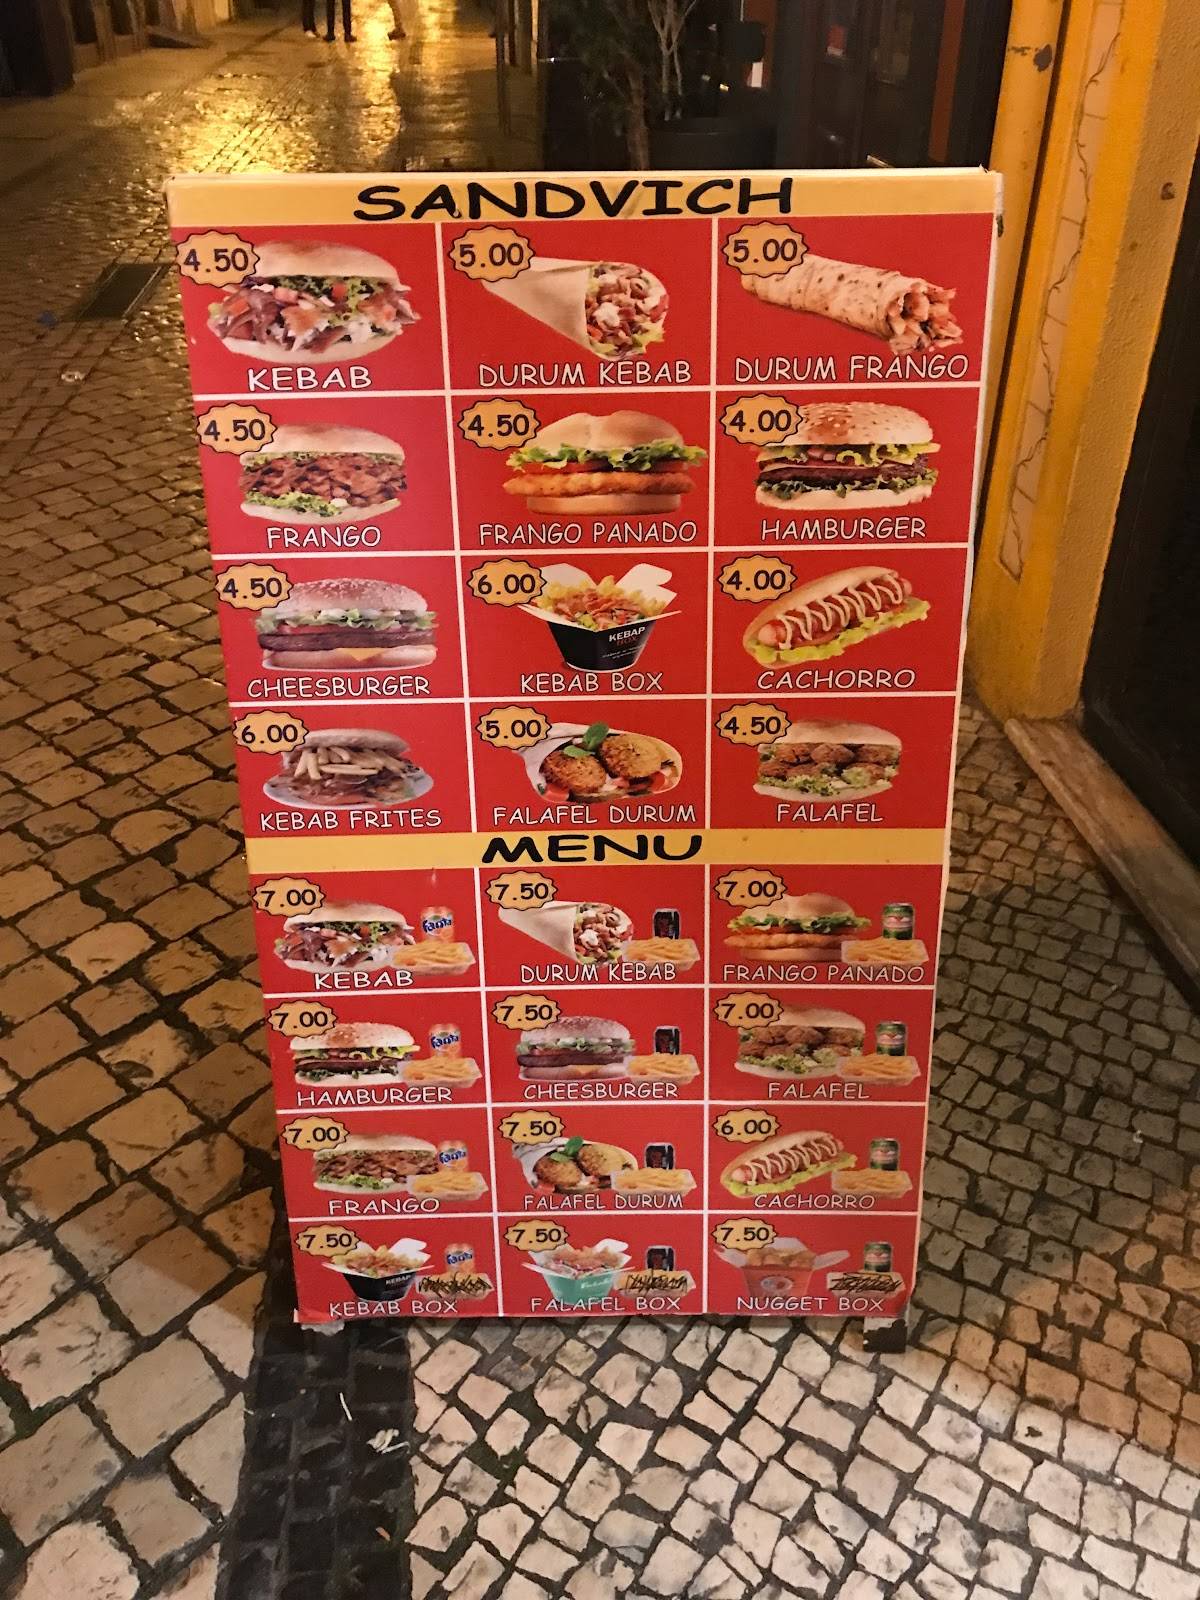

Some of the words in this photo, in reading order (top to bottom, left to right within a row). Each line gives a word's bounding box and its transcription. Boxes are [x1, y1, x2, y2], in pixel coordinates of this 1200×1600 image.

[353, 177, 794, 220] SANDVICH
[183, 248, 249, 273] 4.50
[458, 242, 524, 267] 5.00
[732, 238, 798, 263] 5.00
[246, 365, 372, 392] KEBAB
[479, 363, 585, 387] DURUM
[599, 360, 692, 385] KEBAB
[734, 356, 836, 383] DURUM
[849, 354, 969, 381] FRANGO
[204, 418, 266, 442] 4.50
[468, 414, 530, 438] 4.50
[729, 409, 792, 433] 4.00
[266, 526, 381, 549] FRANGO
[479, 523, 582, 546] FRANGO
[592, 521, 697, 543] PANADO
[761, 517, 927, 541] HAMBURGER
[222, 577, 282, 599] 4.50
[477, 573, 536, 595] 6.00
[726, 569, 787, 592] 4.00
[608, 626, 646, 642] KEBAP
[247, 675, 431, 699] CHEESBURGER
[520, 673, 599, 694] KEBAB
[611, 672, 663, 692] BOX
[756, 669, 916, 690] CACHORRO
[240, 723, 298, 744] 6.00
[485, 719, 542, 740] 5.00
[723, 715, 782, 736] 4.50
[260, 810, 339, 831] KEBAB
[349, 809, 442, 829] FRITES
[493, 805, 598, 825] FALAFEL
[609, 804, 696, 824] DURUM
[776, 803, 884, 823] FALAFEL
[481, 834, 703, 864] MENU
[261, 888, 317, 908] 7.00
[494, 882, 550, 901] 7.50
[723, 880, 778, 899] 7.00
[313, 970, 414, 990] KEBAB
[520, 963, 599, 983] DURUM
[608, 962, 676, 982] KEBAB
[723, 964, 817, 982] FRANGO
[827, 964, 925, 982] PANADO
[276, 1010, 329, 1029] 7.00
[499, 1004, 553, 1022] 7.50
[721, 1001, 775, 1020] 7.00
[296, 1086, 452, 1107] HAMBURGER
[524, 1082, 679, 1100] CHEESBURGER
[767, 1083, 869, 1100] FALAFEL
[288, 1126, 341, 1144] 7.00
[505, 1120, 557, 1138] 7.50
[720, 1118, 773, 1136] 6.00
[328, 1197, 440, 1216] FRANGO
[523, 1194, 606, 1211] FALAFEL
[615, 1193, 683, 1209] DURUM
[754, 1193, 875, 1210] CACHORRO
[302, 1233, 352, 1249] 7.50
[512, 1228, 562, 1244] 7.50
[720, 1226, 771, 1242] 7.50
[329, 1301, 400, 1318] KEBAB
[412, 1300, 458, 1314] BOX
[531, 1297, 625, 1312] FALAFEL
[636, 1296, 681, 1311] BOX
[737, 1296, 829, 1311] NUGGET
[838, 1297, 884, 1311] BOX
